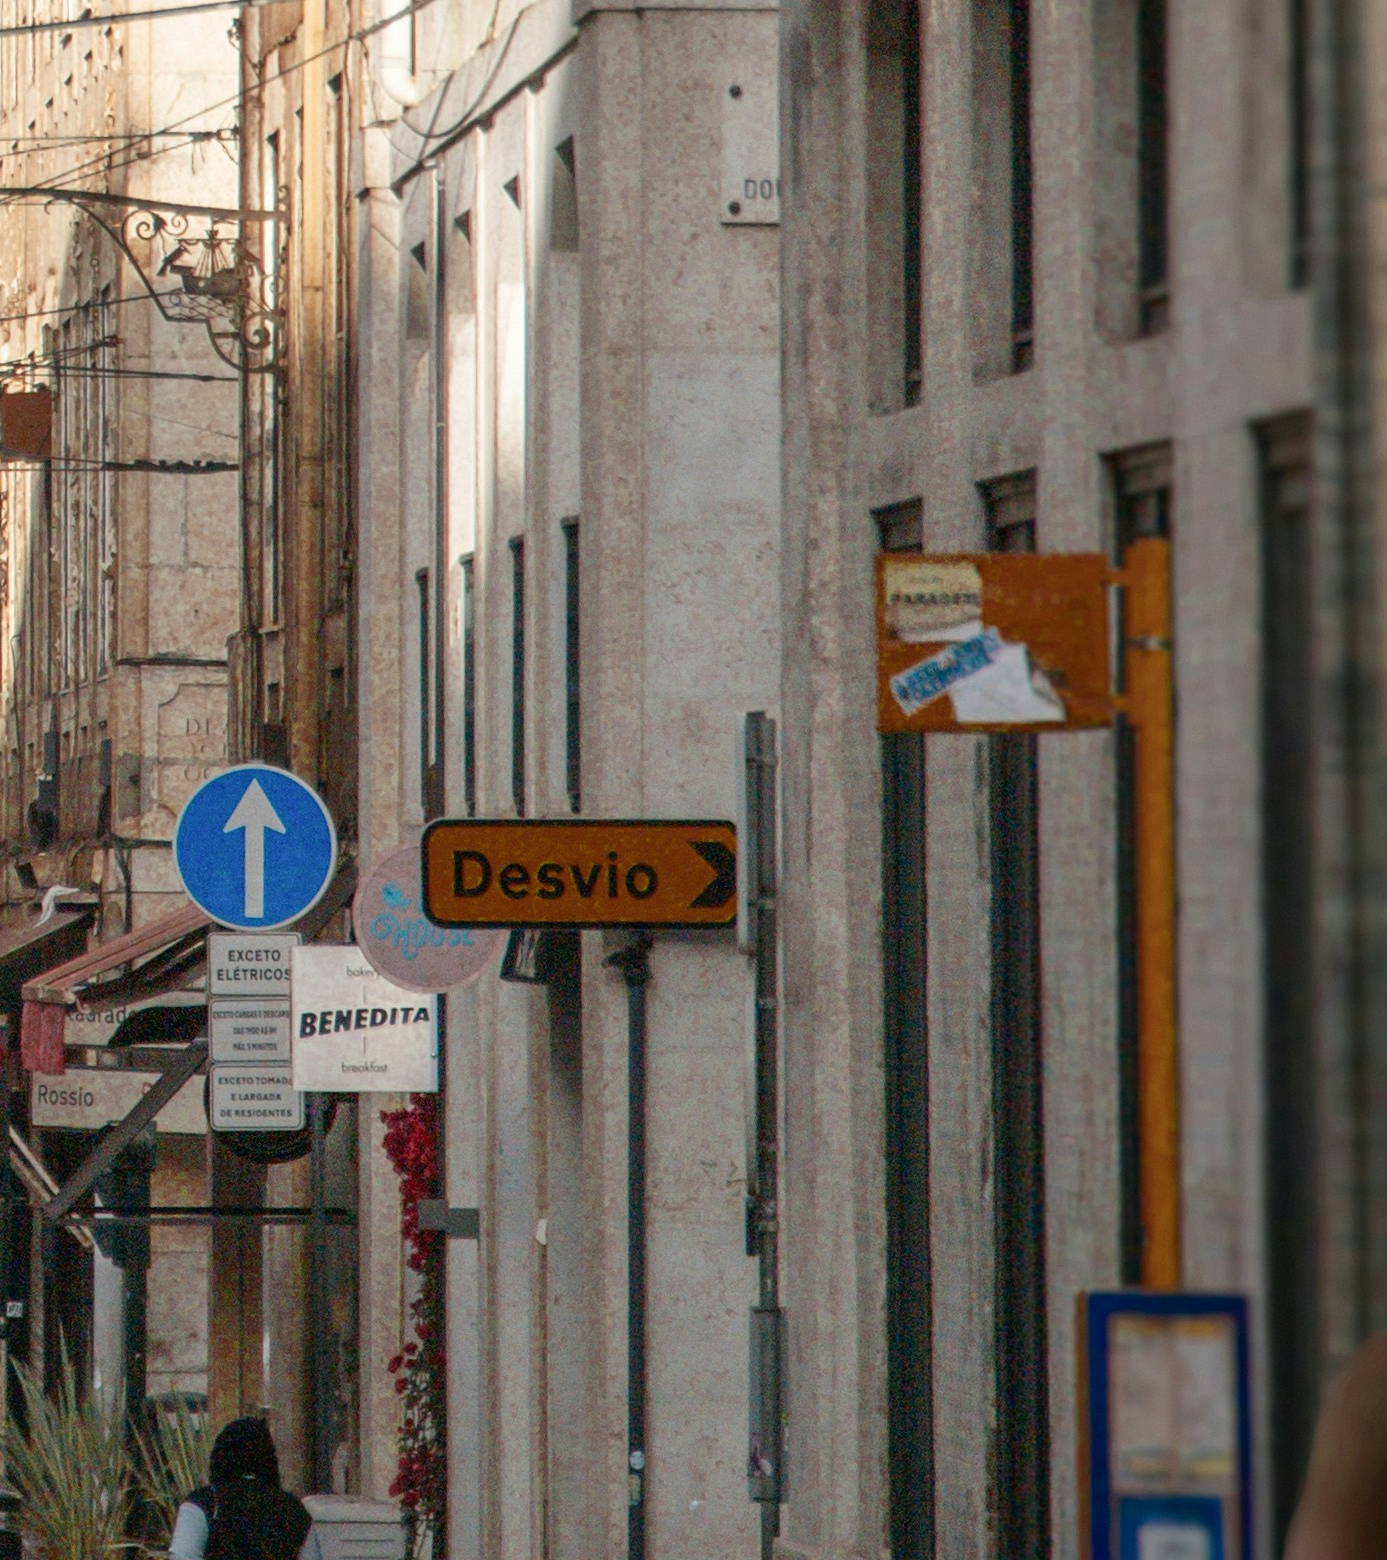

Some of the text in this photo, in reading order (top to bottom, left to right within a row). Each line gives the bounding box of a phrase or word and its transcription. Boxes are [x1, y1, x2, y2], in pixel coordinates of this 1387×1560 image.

[744, 179, 779, 200] DO
[453, 850, 659, 900] Desvio
[228, 950, 281, 962] EXCETO
[298, 1006, 431, 1039] BENEDITA
[341, 1061, 388, 1073] breakfast
[218, 1076, 254, 1085] EXCETO
[38, 1084, 94, 1107] Rossio
[238, 1093, 281, 1101] LARGADA
[220, 1109, 292, 1118] DE RESIDENTES
